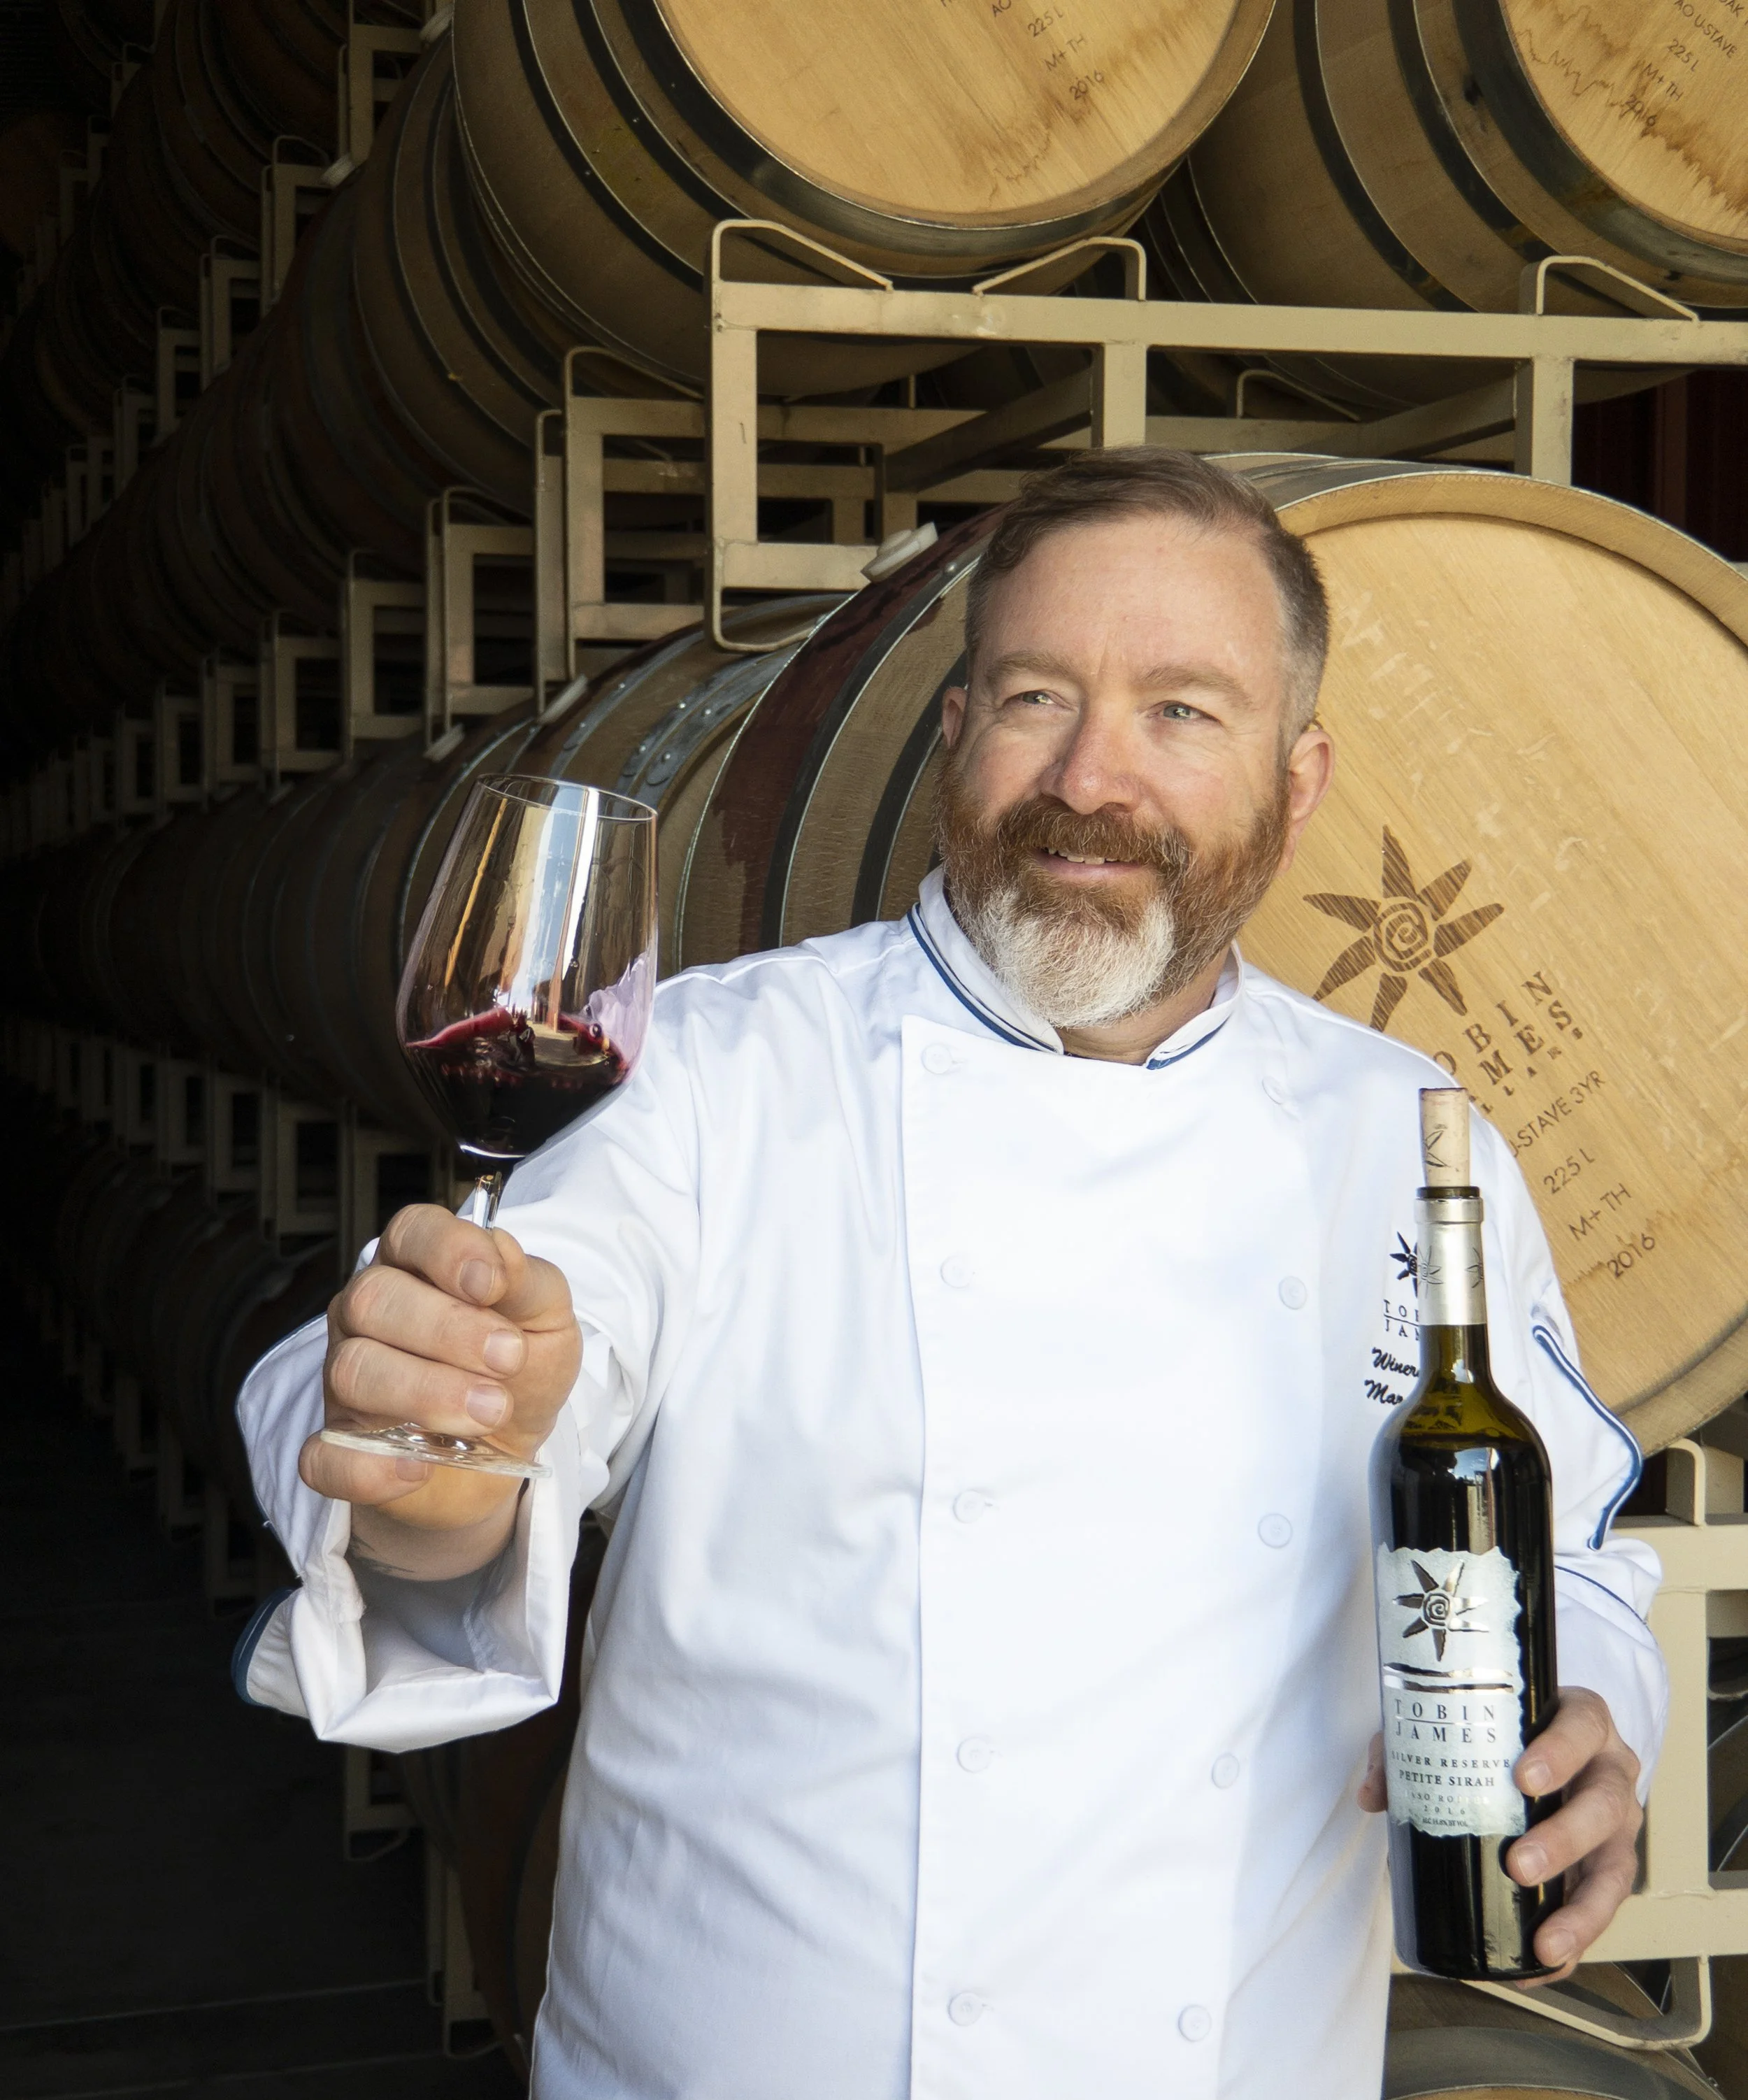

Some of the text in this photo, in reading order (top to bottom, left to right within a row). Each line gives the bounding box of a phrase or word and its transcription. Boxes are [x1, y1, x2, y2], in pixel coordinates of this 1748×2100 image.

[1719, 0, 1745, 17] AK
[1027, 11, 1054, 37] 225
[1667, 38, 1693, 63] 225
[1069, 69, 1105, 101] 2016
[1665, 81, 1684, 101] TH
[1433, 971, 1552, 1076] OBIN
[1472, 1000, 1573, 1093] MES
[1569, 1070, 1606, 1105] 3YR
[1543, 1148, 1595, 1194] 225 L
[1568, 1183, 1631, 1241] M+ TH
[1607, 1232, 1656, 1278] 2016
[1372, 1347, 1419, 1378] Winer
[1395, 1699, 1495, 1721] TOBIN
[1395, 1721, 1496, 1743] JAMES
[1391, 1750, 1510, 1769] SILVER RESERVE
[1399, 1769, 1495, 1787] PETITE SIRAH
[1424, 1804, 1466, 1815] 2016
